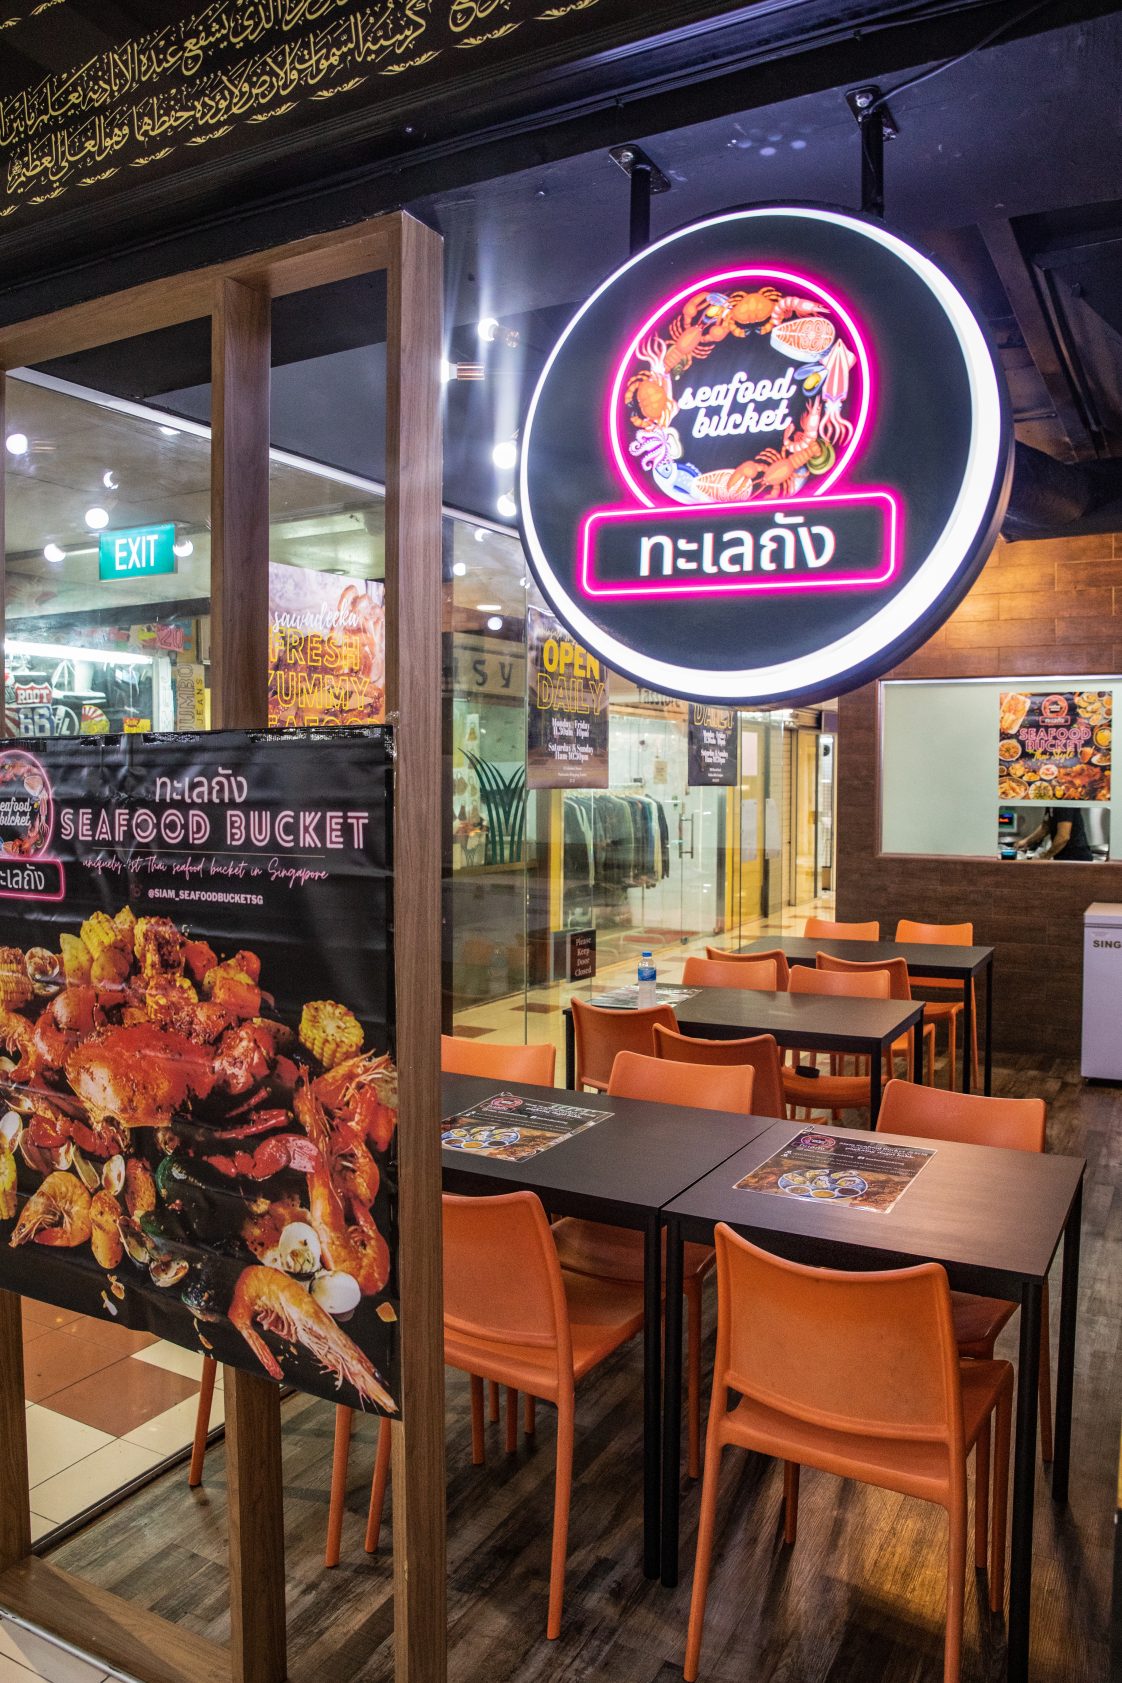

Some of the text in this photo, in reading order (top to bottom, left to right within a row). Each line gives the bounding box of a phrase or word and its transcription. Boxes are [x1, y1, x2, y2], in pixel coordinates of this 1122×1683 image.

[677, 367, 797, 421] seafood
[691, 398, 793, 439] bucket
[115, 534, 159, 571] EXIT
[639, 512, 836, 577] ทะเลถัง
[269, 626, 360, 670] FRESH
[542, 639, 600, 680] OPEN
[177, 663, 195, 732] UMBO
[195, 677, 205, 724] JEANS
[536, 673, 605, 715] DAILY
[19, 707, 51, 736] 66
[1018, 727, 1092, 741] SEAFOOD
[1025, 739, 1085, 752] BUCKET
[155, 766, 248, 803] ทะเลถัง
[0, 797, 32, 819] eafood
[60, 808, 369, 849] SEAFOOD BUCKET
[0, 863, 45, 890] ะเลถัง
[172, 857, 205, 880] seafood
[210, 857, 248, 878] bucket
[250, 867, 263, 877] in
[267, 857, 329, 889] Singapore
[148, 888, 264, 905] @SIAM_SEAFOODBUCKETSG
[574, 966, 592, 977] Closed
